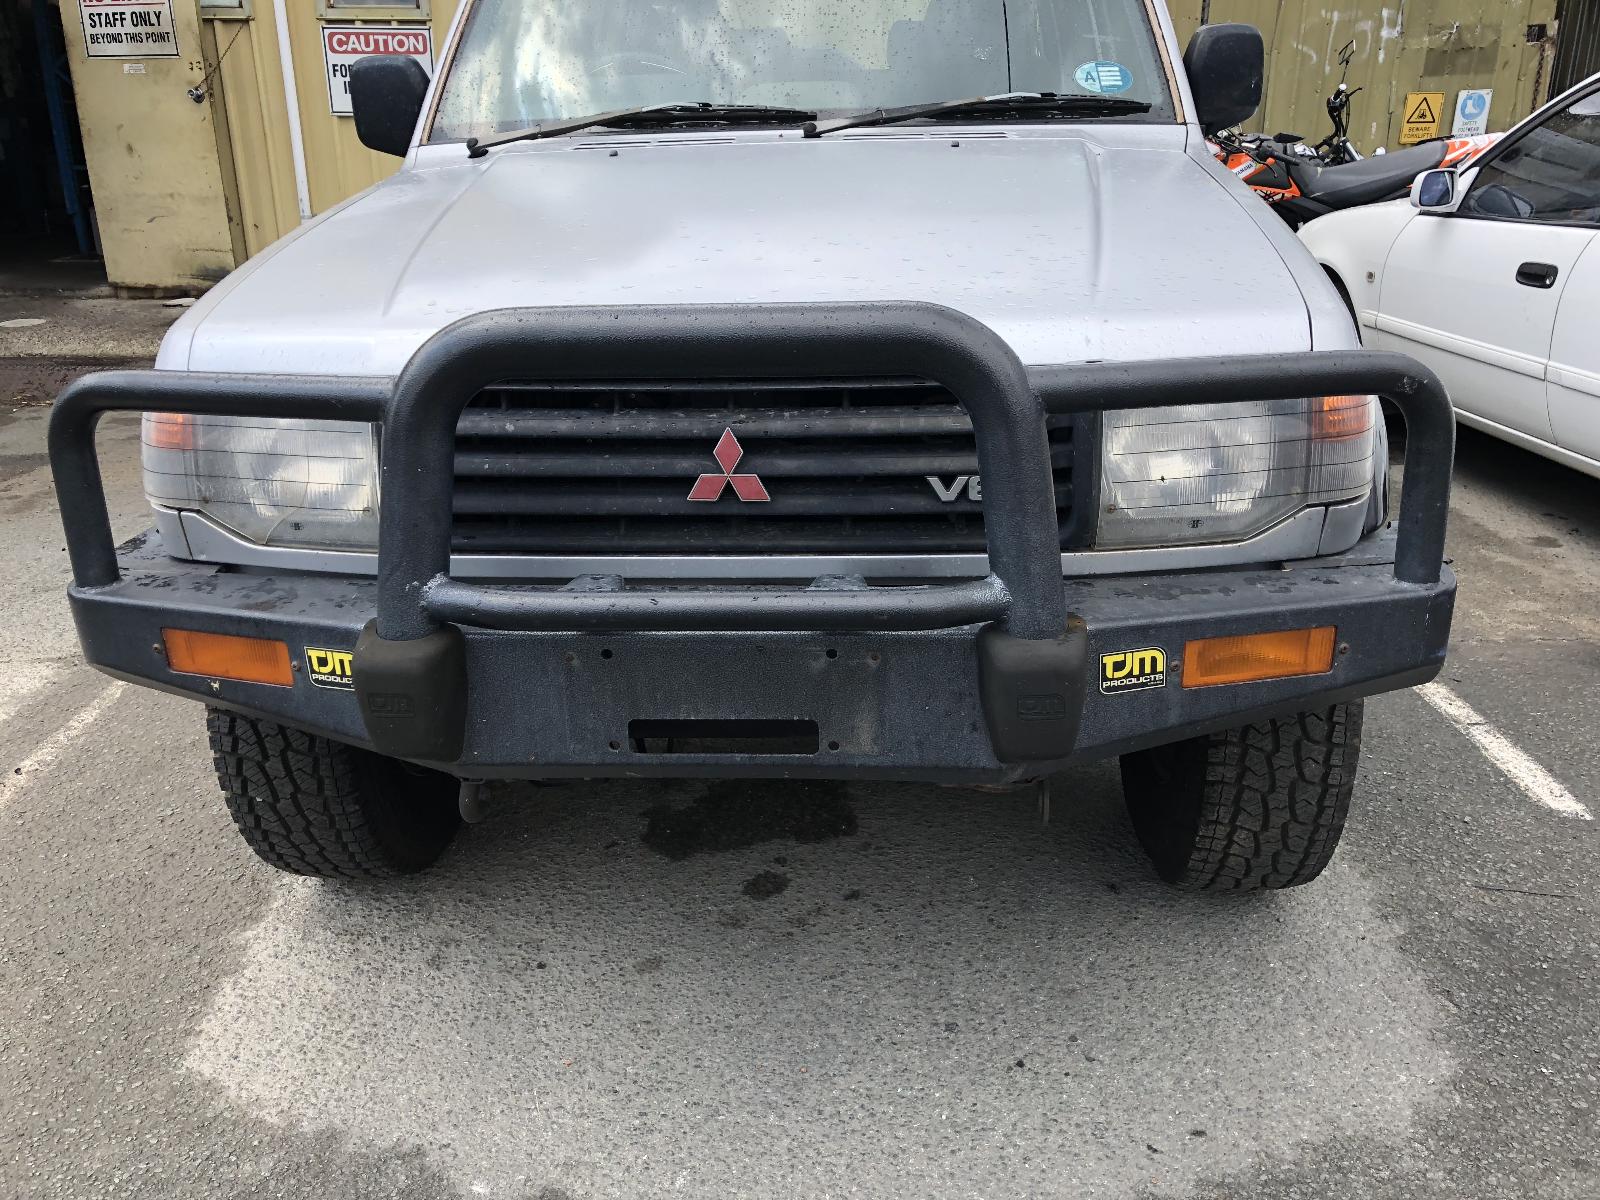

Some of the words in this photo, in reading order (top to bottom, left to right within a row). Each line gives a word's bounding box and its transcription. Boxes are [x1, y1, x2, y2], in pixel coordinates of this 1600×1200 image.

[88, 12, 126, 28] STAFF
[130, 11, 161, 27] ONLY
[90, 33, 123, 44] BEYOND
[124, 33, 143, 43] THIS
[145, 32, 170, 43] POINT
[332, 34, 424, 52] CAUTION
[1084, 71, 1096, 82] A
[1103, 649, 1163, 679] TJM
[312, 674, 353, 683] PRODUC
[1103, 674, 1163, 689] PRODUCTS
